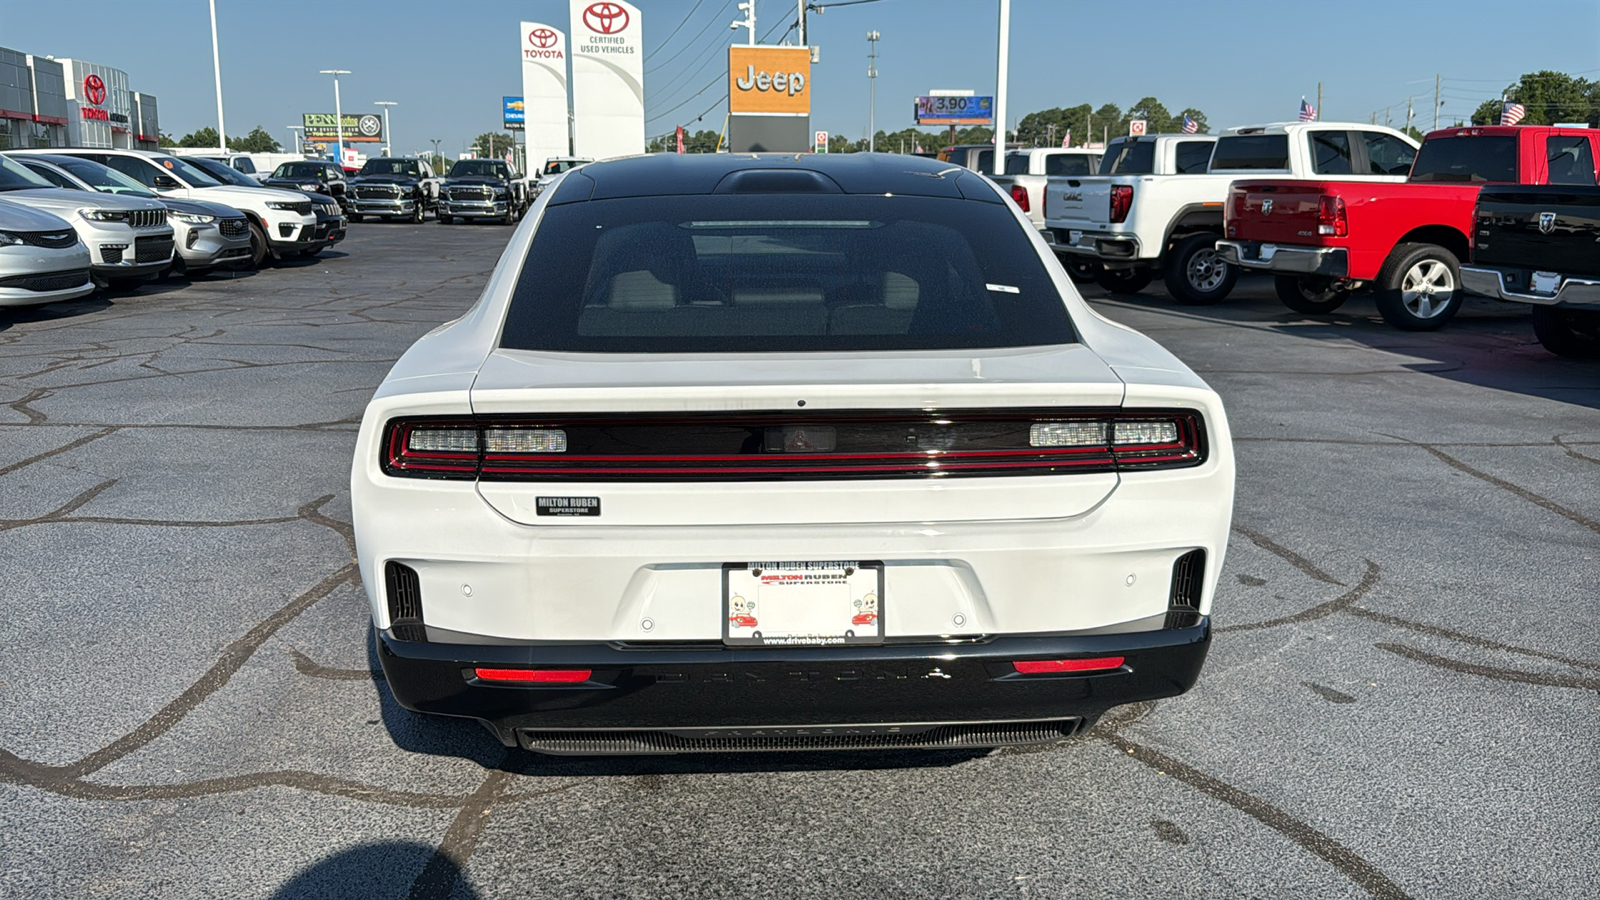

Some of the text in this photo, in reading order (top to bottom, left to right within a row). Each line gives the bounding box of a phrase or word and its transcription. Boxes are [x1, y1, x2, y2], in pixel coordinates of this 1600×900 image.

[590, 36, 625, 44] CERTIFIED
[524, 49, 564, 59] TOYOTA
[580, 45, 635, 54] USED VEHICLES
[736, 65, 805, 97] Jeep
[538, 497, 598, 508] MILTON RUBEN
[747, 561, 860, 570] MILTON RUBEN SUPERSTORE
[763, 637, 846, 645] www.drivebaby.com
